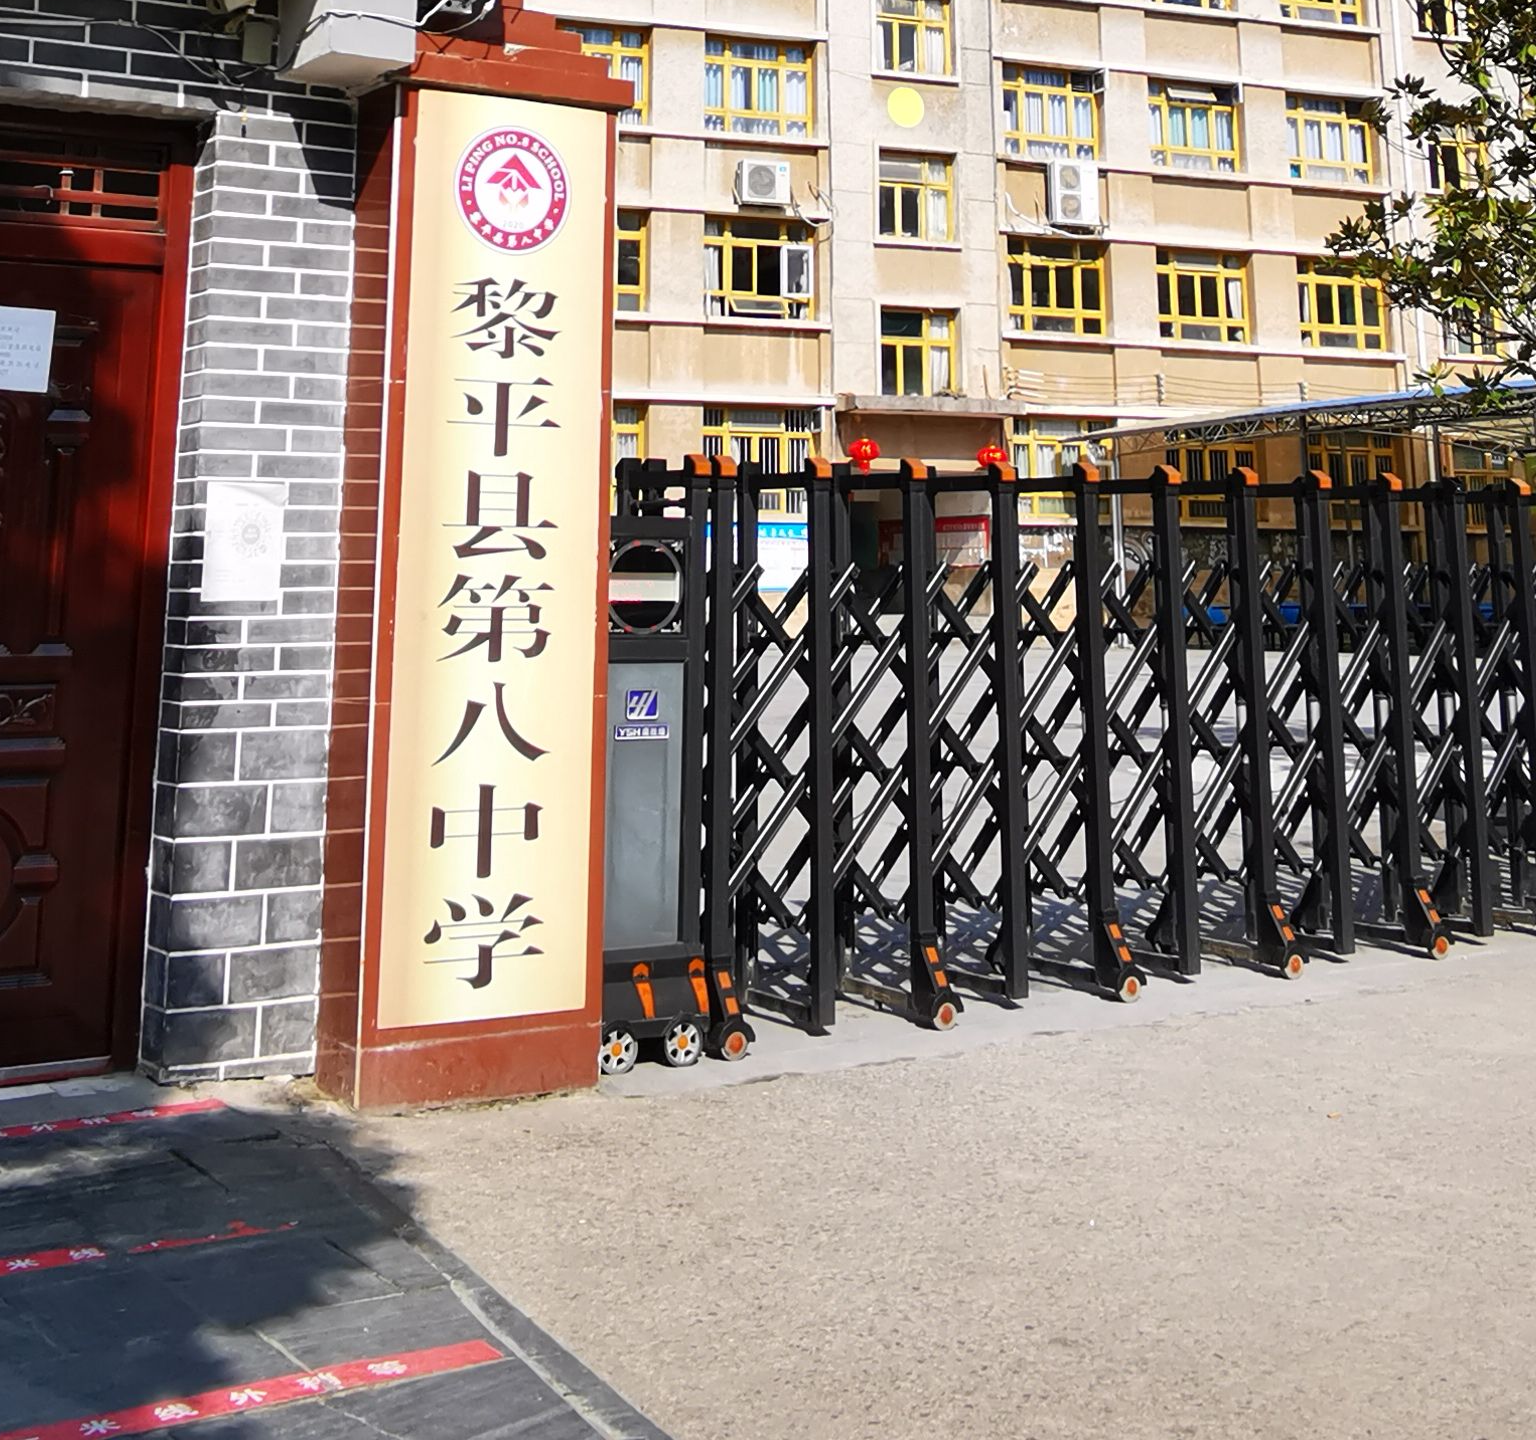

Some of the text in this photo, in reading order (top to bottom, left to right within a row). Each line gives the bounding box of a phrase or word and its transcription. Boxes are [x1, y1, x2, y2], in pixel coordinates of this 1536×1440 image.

[465, 141, 493, 174] PING
[531, 142, 565, 202] SCHOOL
[423, 276, 560, 990] 黎平县第八中学
